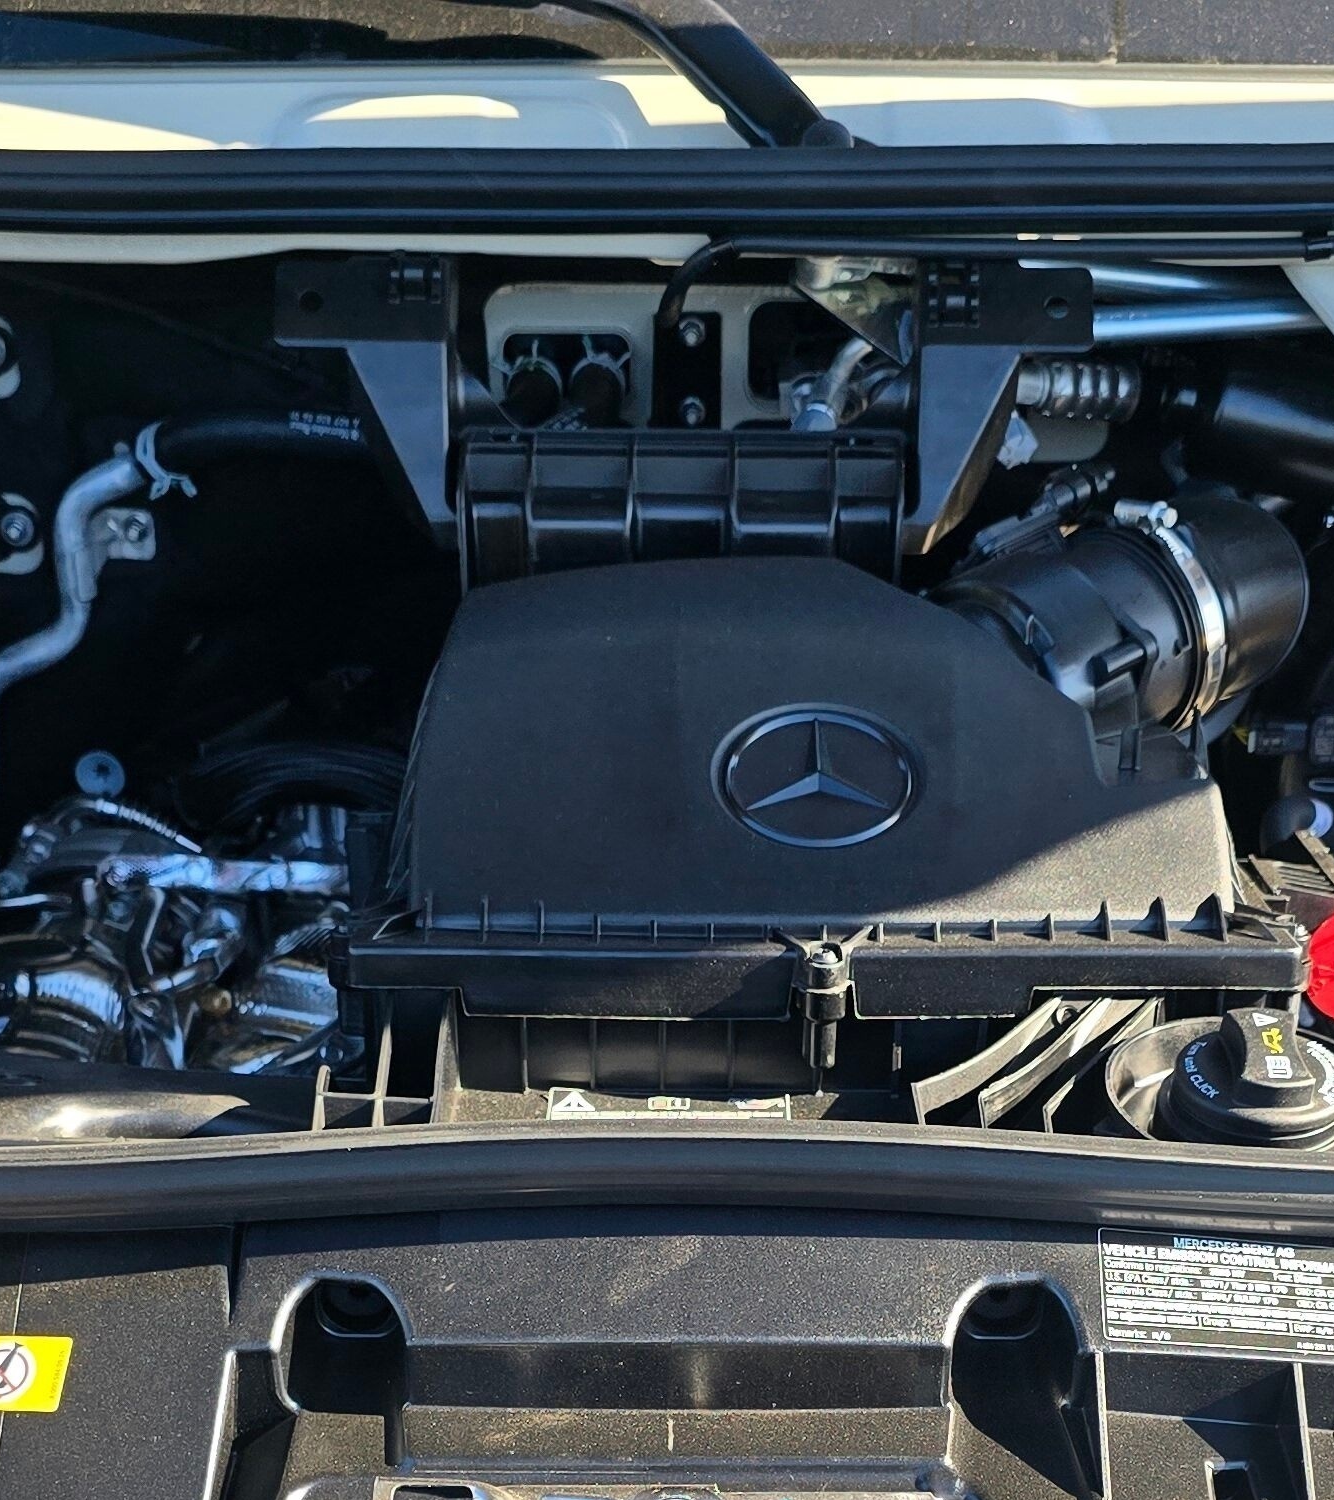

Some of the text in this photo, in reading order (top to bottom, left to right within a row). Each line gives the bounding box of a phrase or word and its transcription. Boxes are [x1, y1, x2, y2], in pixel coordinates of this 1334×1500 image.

[1189, 1074, 1220, 1099] CLICK
[1102, 1243, 1157, 1260] VEHICLE
[1157, 1247, 1219, 1263] EMISSION
[1219, 1252, 1280, 1269] CONTROL
[1173, 1237, 1296, 1259] MERCEDES-BENZ AG
